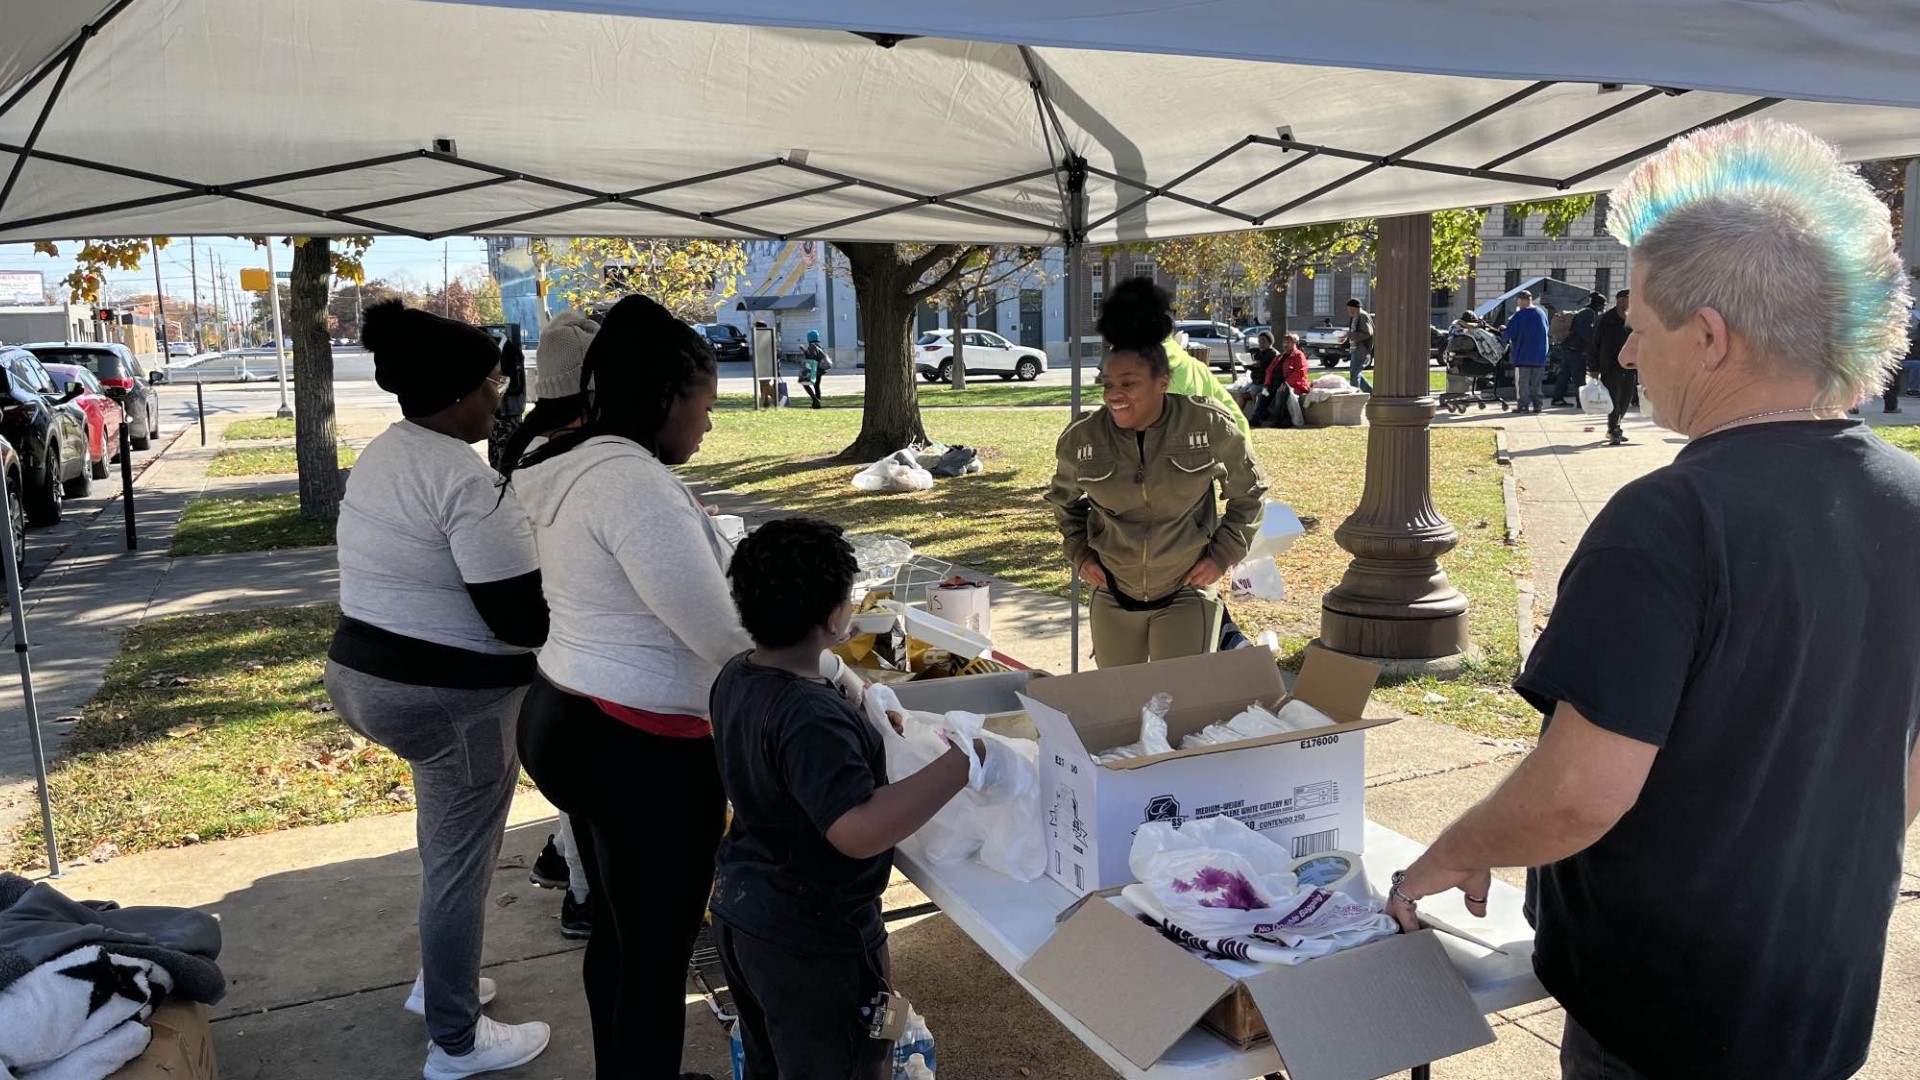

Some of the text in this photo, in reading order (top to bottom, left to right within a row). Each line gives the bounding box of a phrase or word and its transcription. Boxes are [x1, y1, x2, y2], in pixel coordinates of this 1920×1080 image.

[1300, 735, 1339, 749] E176000
[1195, 800, 1245, 815] MEDIUM-WEIGHT
[1241, 805, 1258, 815] WHITE
[1259, 801, 1283, 811] CUTLERY
[1284, 798, 1293, 806] KIT
[1259, 816, 1293, 829] CONTENIDO
[1299, 894, 1323, 917] Bagging
